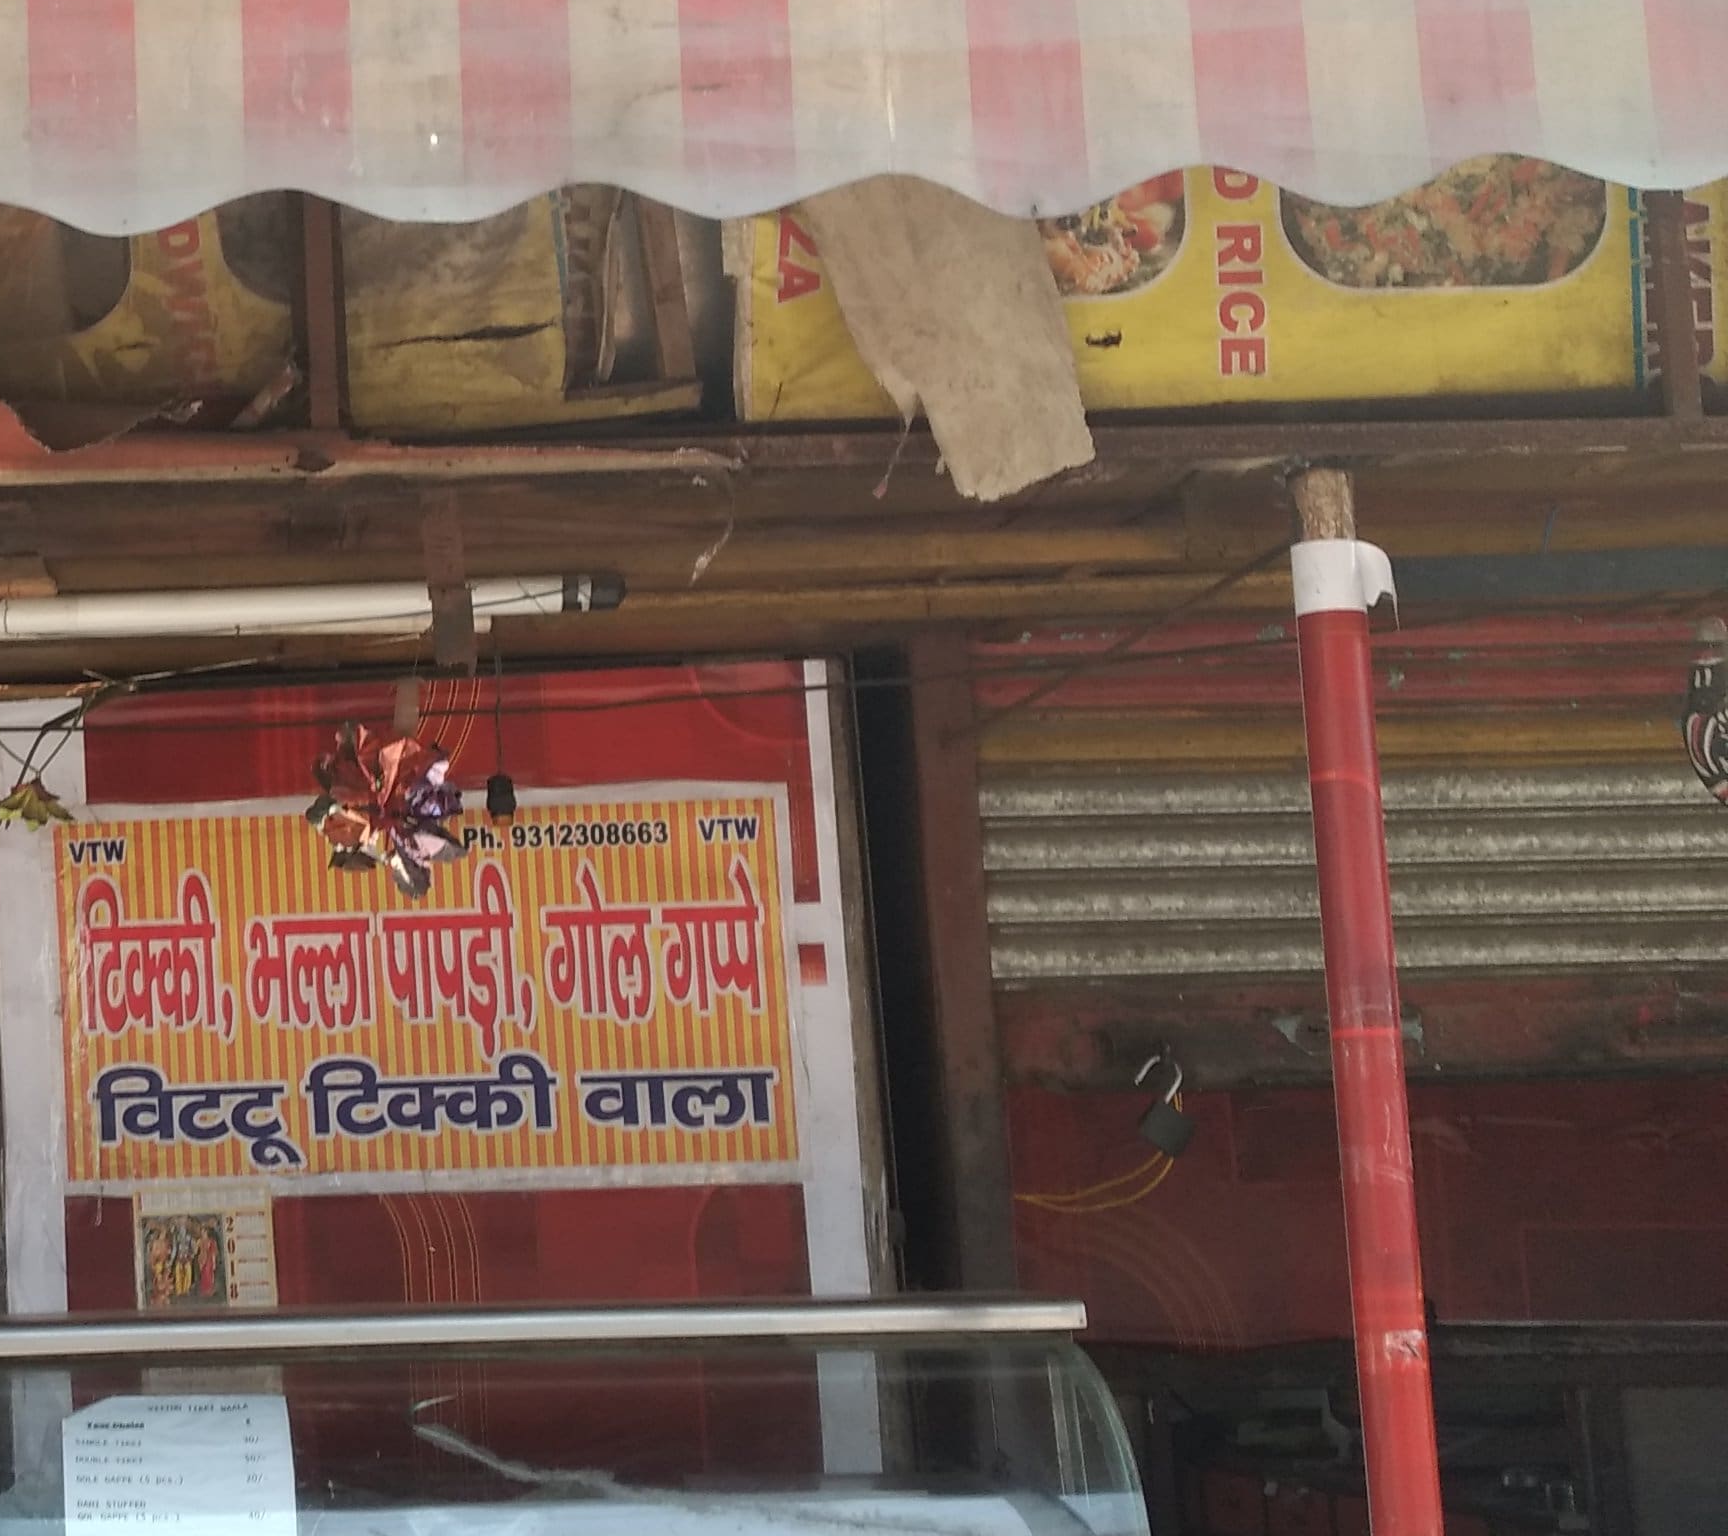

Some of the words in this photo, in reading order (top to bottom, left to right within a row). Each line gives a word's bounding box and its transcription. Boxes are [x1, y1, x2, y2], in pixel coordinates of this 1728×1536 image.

[1217, 225, 1266, 375] RICE
[69, 839, 125, 865] VTW
[463, 826, 503, 850] Ph.
[511, 821, 669, 849] 9312308663
[699, 816, 756, 843] VTW
[246, 911, 373, 1031] भल्ला
[544, 861, 657, 1021] गोल
[307, 1054, 556, 1138] टिक्की
[580, 1070, 774, 1129] वाला
